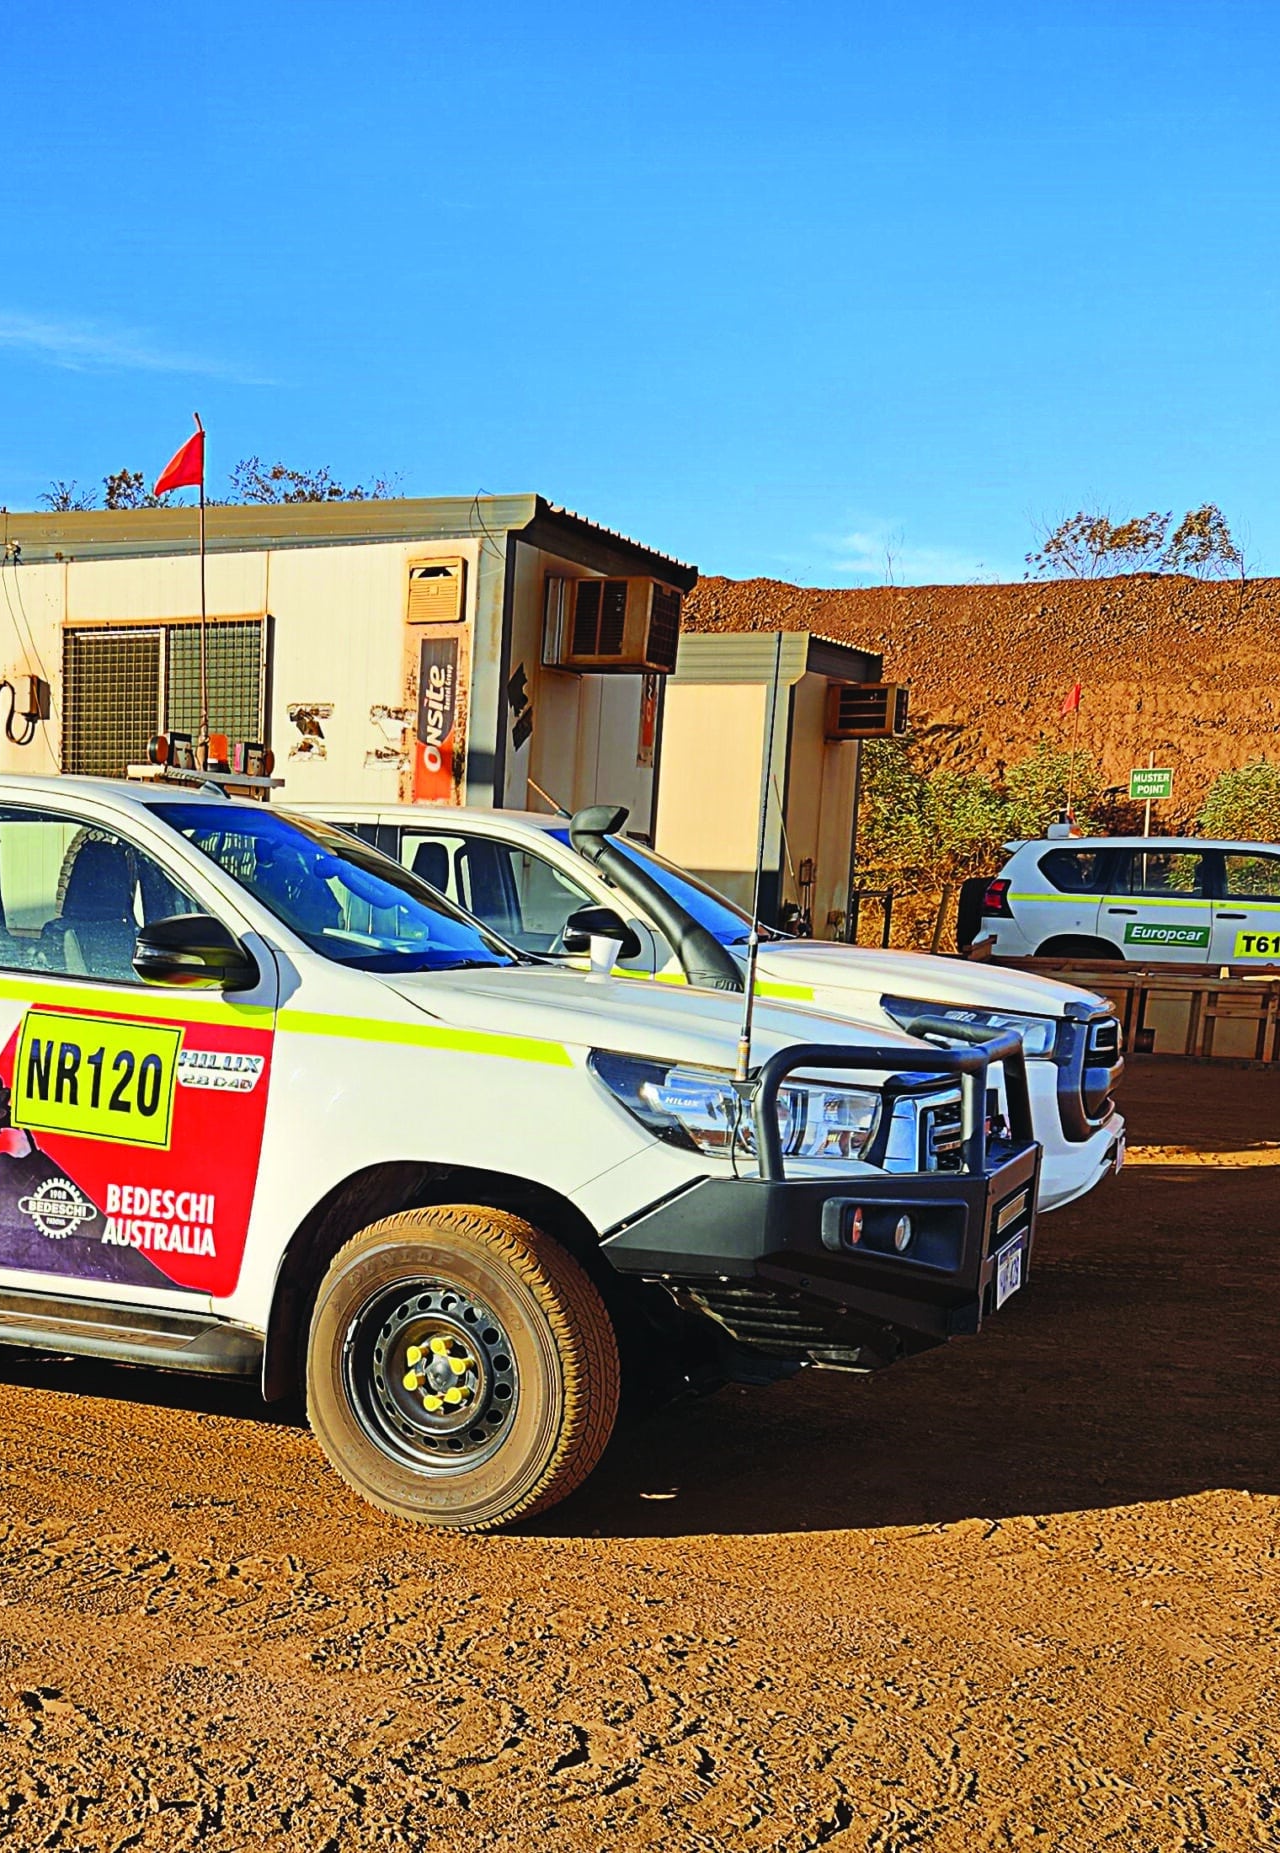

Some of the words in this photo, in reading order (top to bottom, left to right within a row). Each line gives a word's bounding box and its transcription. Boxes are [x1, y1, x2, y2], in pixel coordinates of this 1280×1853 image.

[445, 664, 454, 686] Group
[1133, 773, 1170, 783] MUSTER
[1137, 784, 1165, 795] POINT
[1131, 926, 1204, 944] Europcar
[178, 1051, 261, 1073] HILUX
[26, 1038, 162, 1117] NR120
[665, 1096, 699, 1107] HILUX
[28, 1199, 87, 1217] BEDESCHI
[107, 1183, 215, 1224] BEDESCHI
[101, 1217, 217, 1257] AUSTRALIA
